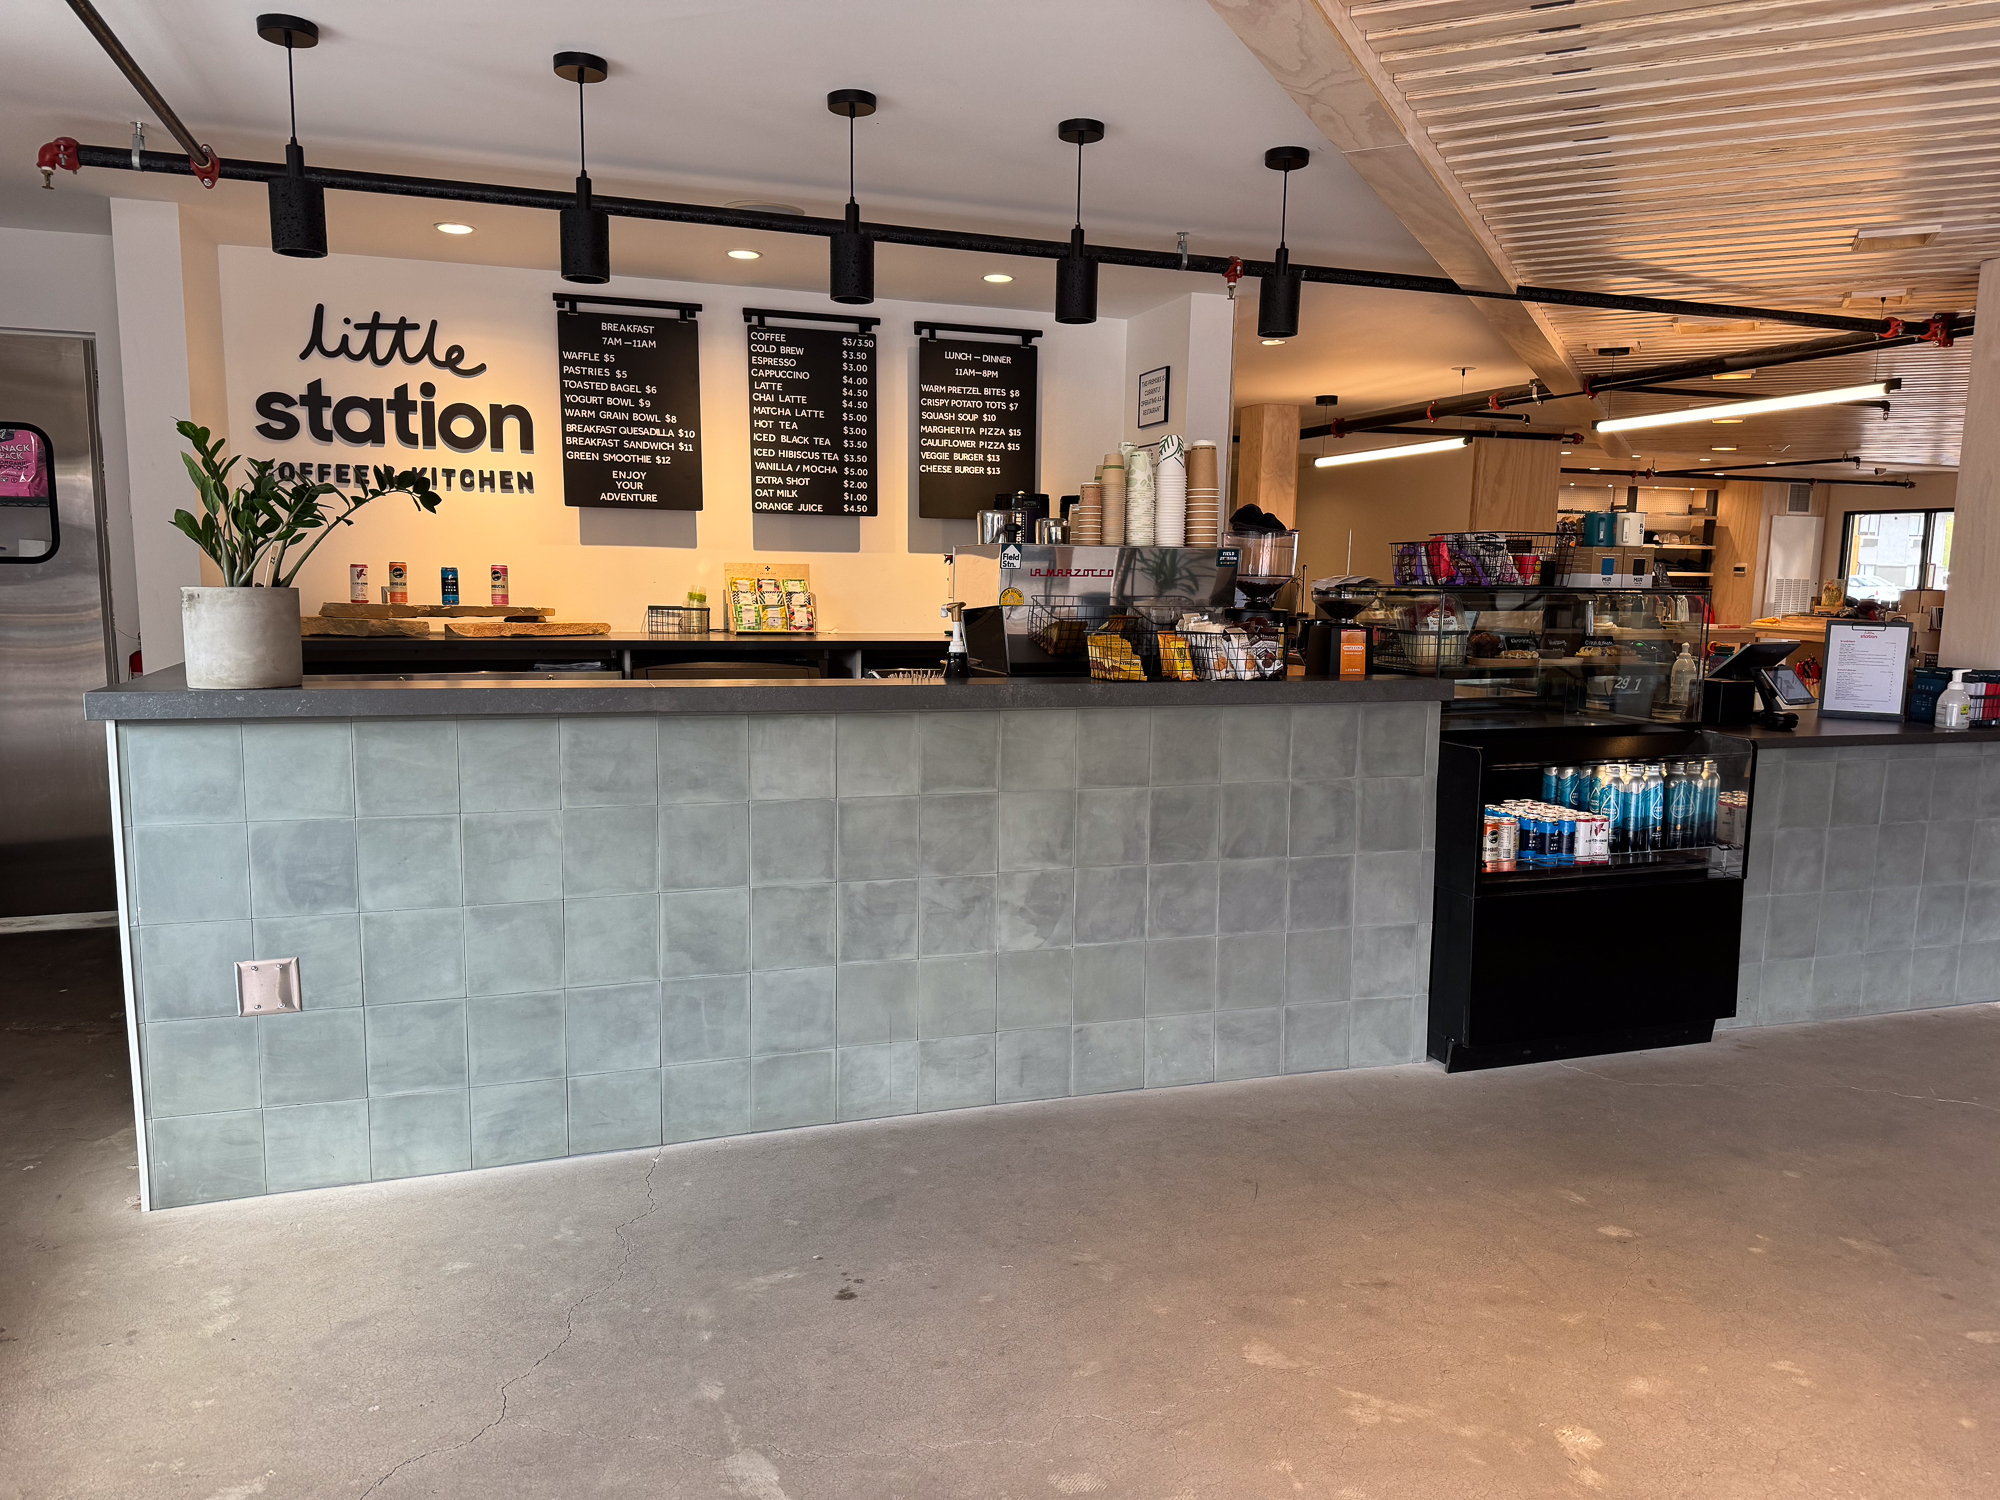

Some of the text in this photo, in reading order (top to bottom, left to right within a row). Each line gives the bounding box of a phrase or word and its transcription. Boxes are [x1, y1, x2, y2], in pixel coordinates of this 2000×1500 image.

[601, 323, 654, 334] BREAKFAST
[299, 303, 487, 378] little
[751, 332, 874, 347] COFFEE $3/3.50
[563, 351, 615, 363] WAFFLE $5
[751, 344, 867, 360] COLD BREW $3.50
[945, 351, 972, 361] LUNCH
[982, 355, 1012, 364] DINNER
[752, 357, 868, 372] ESPRESSO $3.00
[563, 366, 628, 378] PASTRIES $5
[751, 369, 868, 385] CAPPUCCINO $4.00
[563, 380, 657, 394] TOASTED BAGEL $6
[755, 382, 868, 397] LATTE $4.50
[921, 384, 1020, 398] WARM PRETZEL BITES $8
[565, 394, 650, 408] YOGURT BOWL $9
[753, 393, 868, 409] CHAI LATTE $4.50
[921, 398, 1018, 411] CRISPY POTATO TOTS $7
[254, 378, 534, 454] station
[565, 409, 677, 423] WARM GRAIN BOWL $8
[753, 407, 867, 422] MATCHA LATTE $5.00
[921, 412, 996, 422] SQUASH SOUP $10
[566, 424, 695, 439] BREAKFAST QUESADILLA $10
[754, 420, 867, 436] HOT TEA $3.00
[921, 426, 1021, 437] MARGHERITA PIZZA $15
[566, 437, 693, 451] BREAKFAST SANDWICH $11
[753, 433, 867, 449] ICED BLACK TEA $3.50
[921, 439, 1020, 451] CAULIFLOWER PIZZA $15
[566, 451, 671, 464] GREEN SMOOTHIE $12
[754, 448, 867, 463] ICED HIBISCUS TEA $3.50
[921, 452, 1000, 462] VEGGIE BURGER $13
[261, 460, 370, 488] OFFEE
[612, 471, 646, 480] ENJOY
[755, 462, 793, 472] VANILLA
[803, 465, 838, 474] MOCHA
[844, 467, 868, 476] $5.00
[919, 465, 1000, 475] CHEESE BURGER $13
[616, 481, 643, 490] YOUR
[756, 476, 868, 489] EXTRA SHOT $2.00
[600, 493, 657, 502] ADVENTURE
[755, 489, 868, 501] OAT MILK $1.00
[755, 502, 868, 513] ORANGE JUICE $4.50
